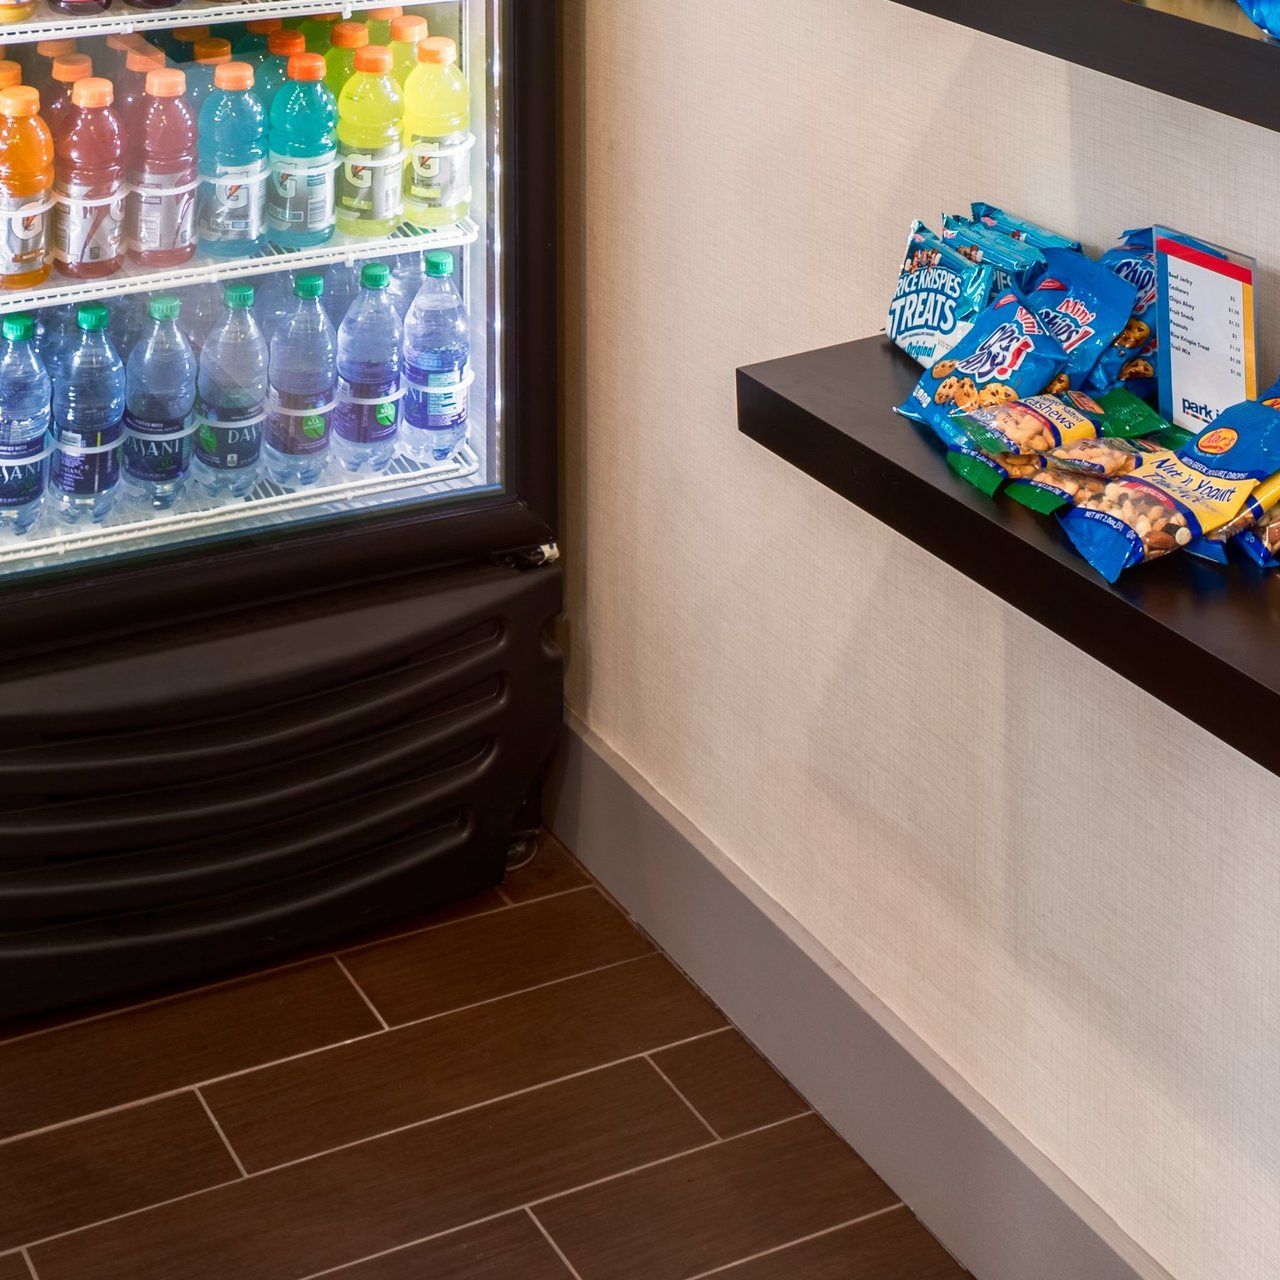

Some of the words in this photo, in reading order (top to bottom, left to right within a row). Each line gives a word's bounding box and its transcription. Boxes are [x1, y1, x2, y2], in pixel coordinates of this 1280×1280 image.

[895, 271, 920, 298] RICE
[919, 268, 962, 298] KRISPIES
[889, 292, 956, 339] TREATS
[1057, 298, 1096, 326] Mini
[1024, 397, 1076, 431] cashews
[1181, 396, 1213, 421] park
